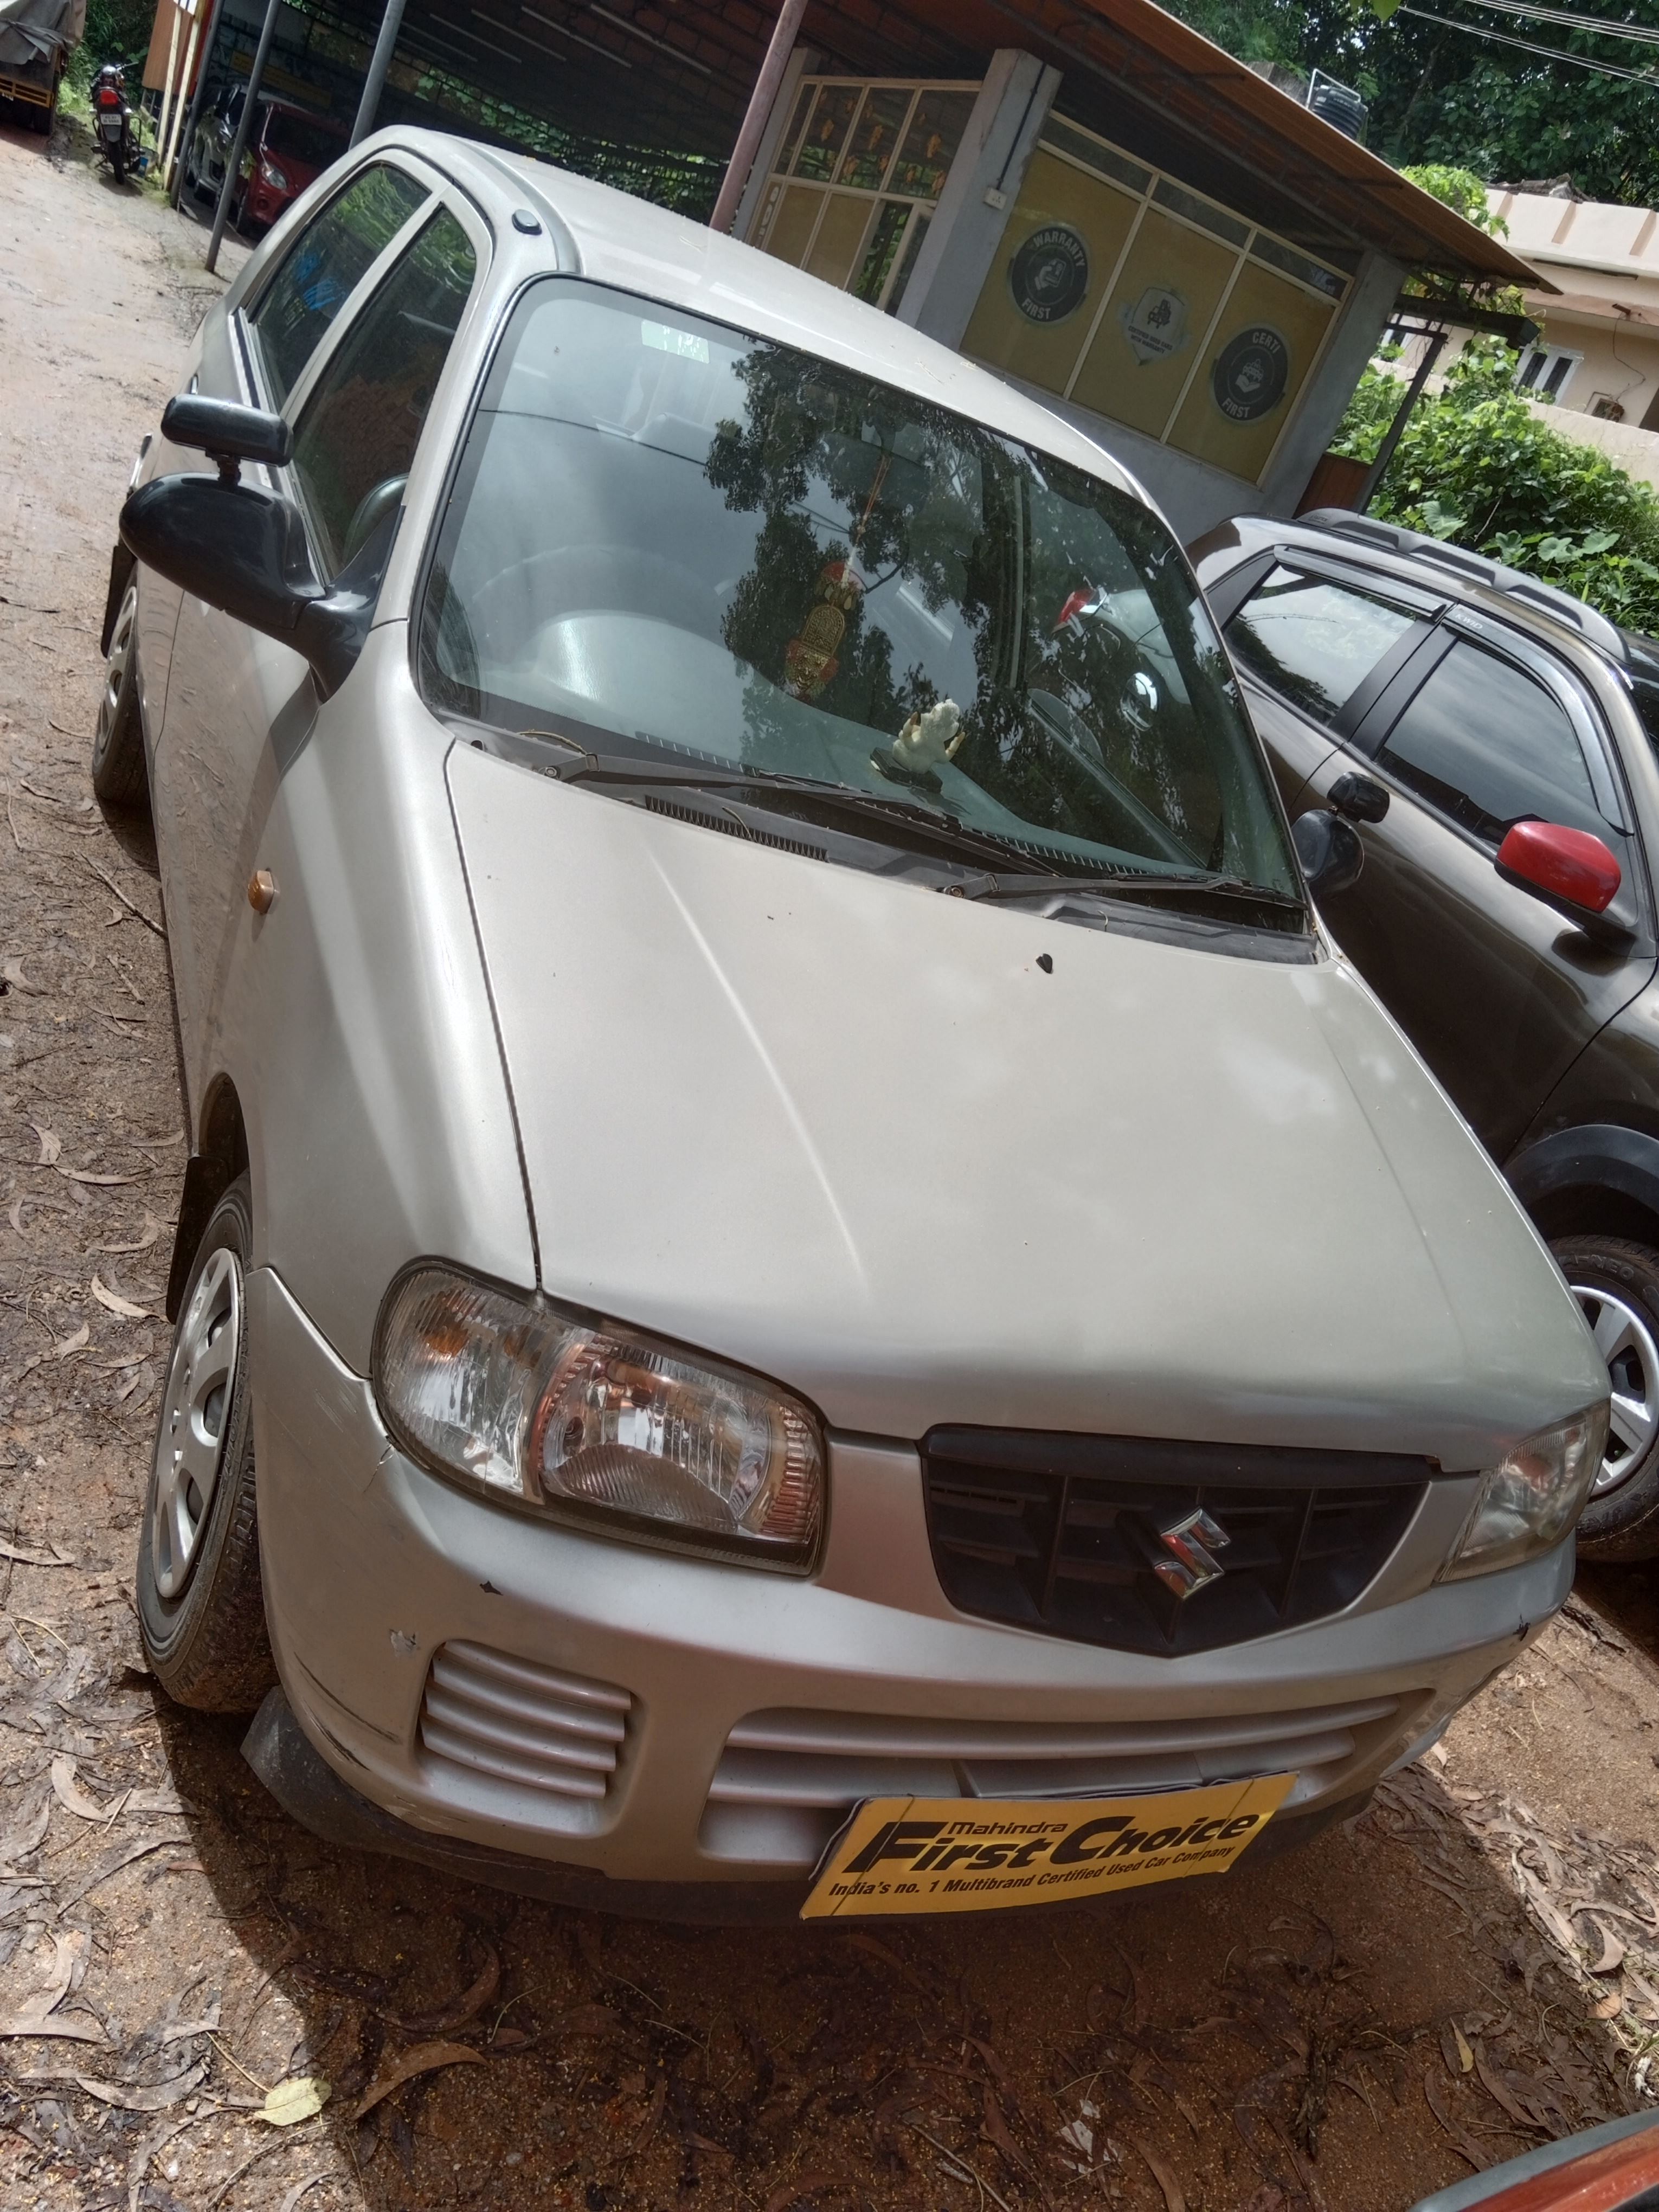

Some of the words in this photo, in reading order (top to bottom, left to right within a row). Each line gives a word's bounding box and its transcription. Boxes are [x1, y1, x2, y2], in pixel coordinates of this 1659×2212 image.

[1033, 230, 1085, 267] WARRANTY
[1022, 298, 1051, 319] FIRST
[1252, 332, 1281, 353] CERTI
[1221, 397, 1250, 417] FIRST
[1455, 614, 1483, 629] KWID
[948, 1821, 1068, 1835] Mahindra
[841, 1821, 1054, 1873] First
[1050, 1814, 1261, 1865] Choice
[828, 1881, 891, 1896] India's
[894, 1883, 920, 1894] no.
[929, 1880, 940, 1893] 1
[942, 1874, 1037, 1892] Multibrand
[1037, 1866, 1105, 1886] Certified
[1106, 1860, 1145, 1876] Used
[1144, 1856, 1170, 1869] Car
[1172, 1846, 1236, 1864] Company
